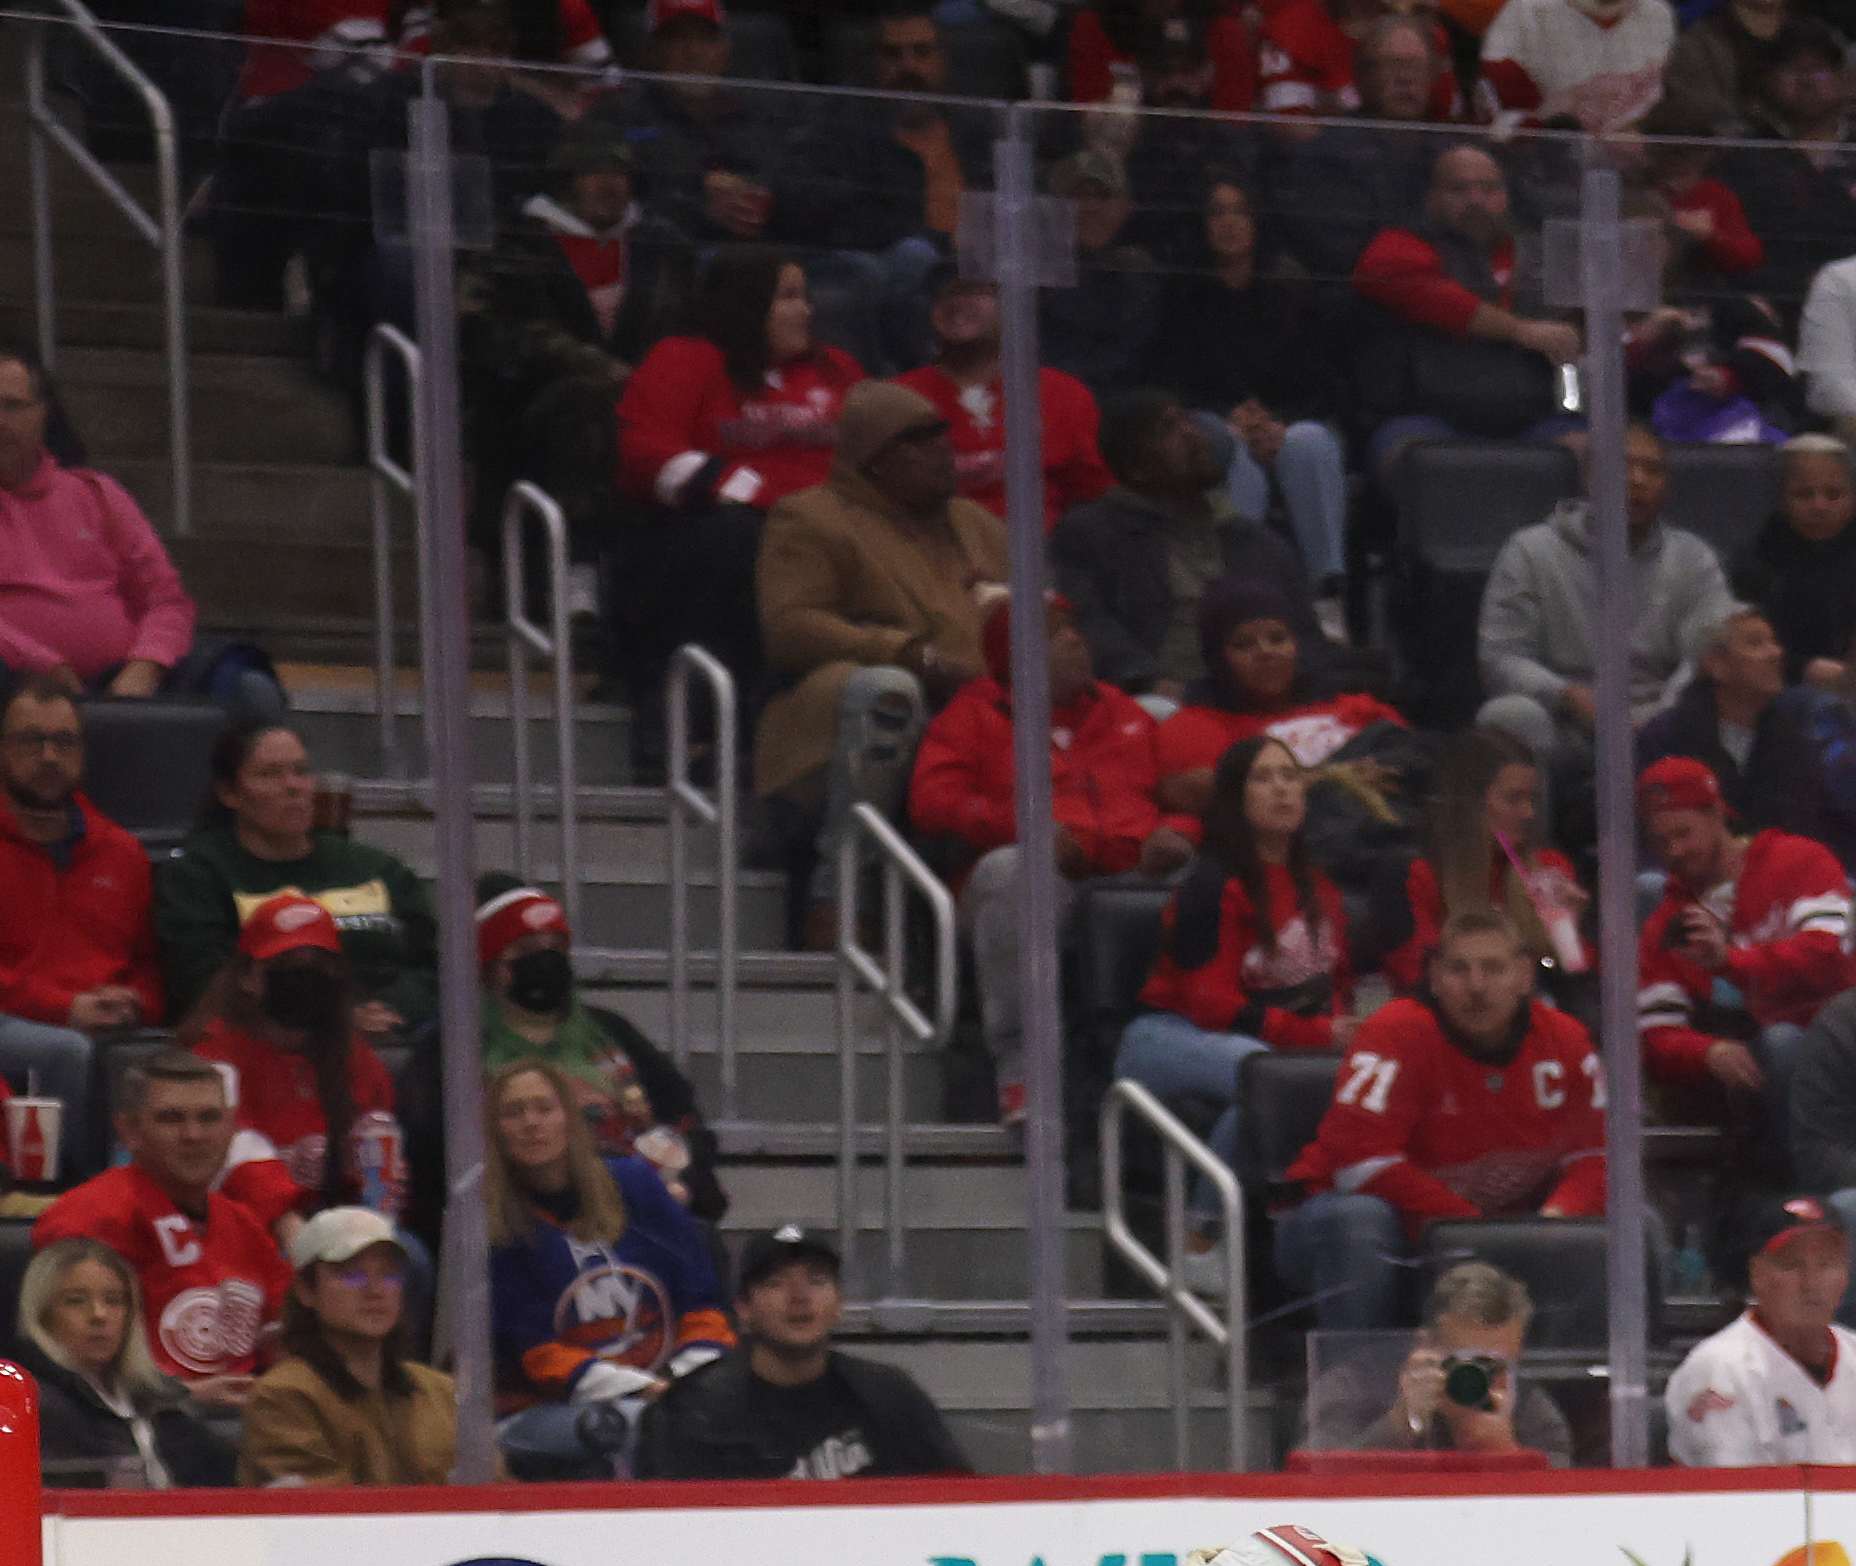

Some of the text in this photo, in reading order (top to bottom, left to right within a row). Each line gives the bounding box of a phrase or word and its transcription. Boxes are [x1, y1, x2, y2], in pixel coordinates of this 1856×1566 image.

[1335, 1052, 1398, 1113] 71
[1533, 1061, 1564, 1109] C
[153, 1216, 201, 1264] C
